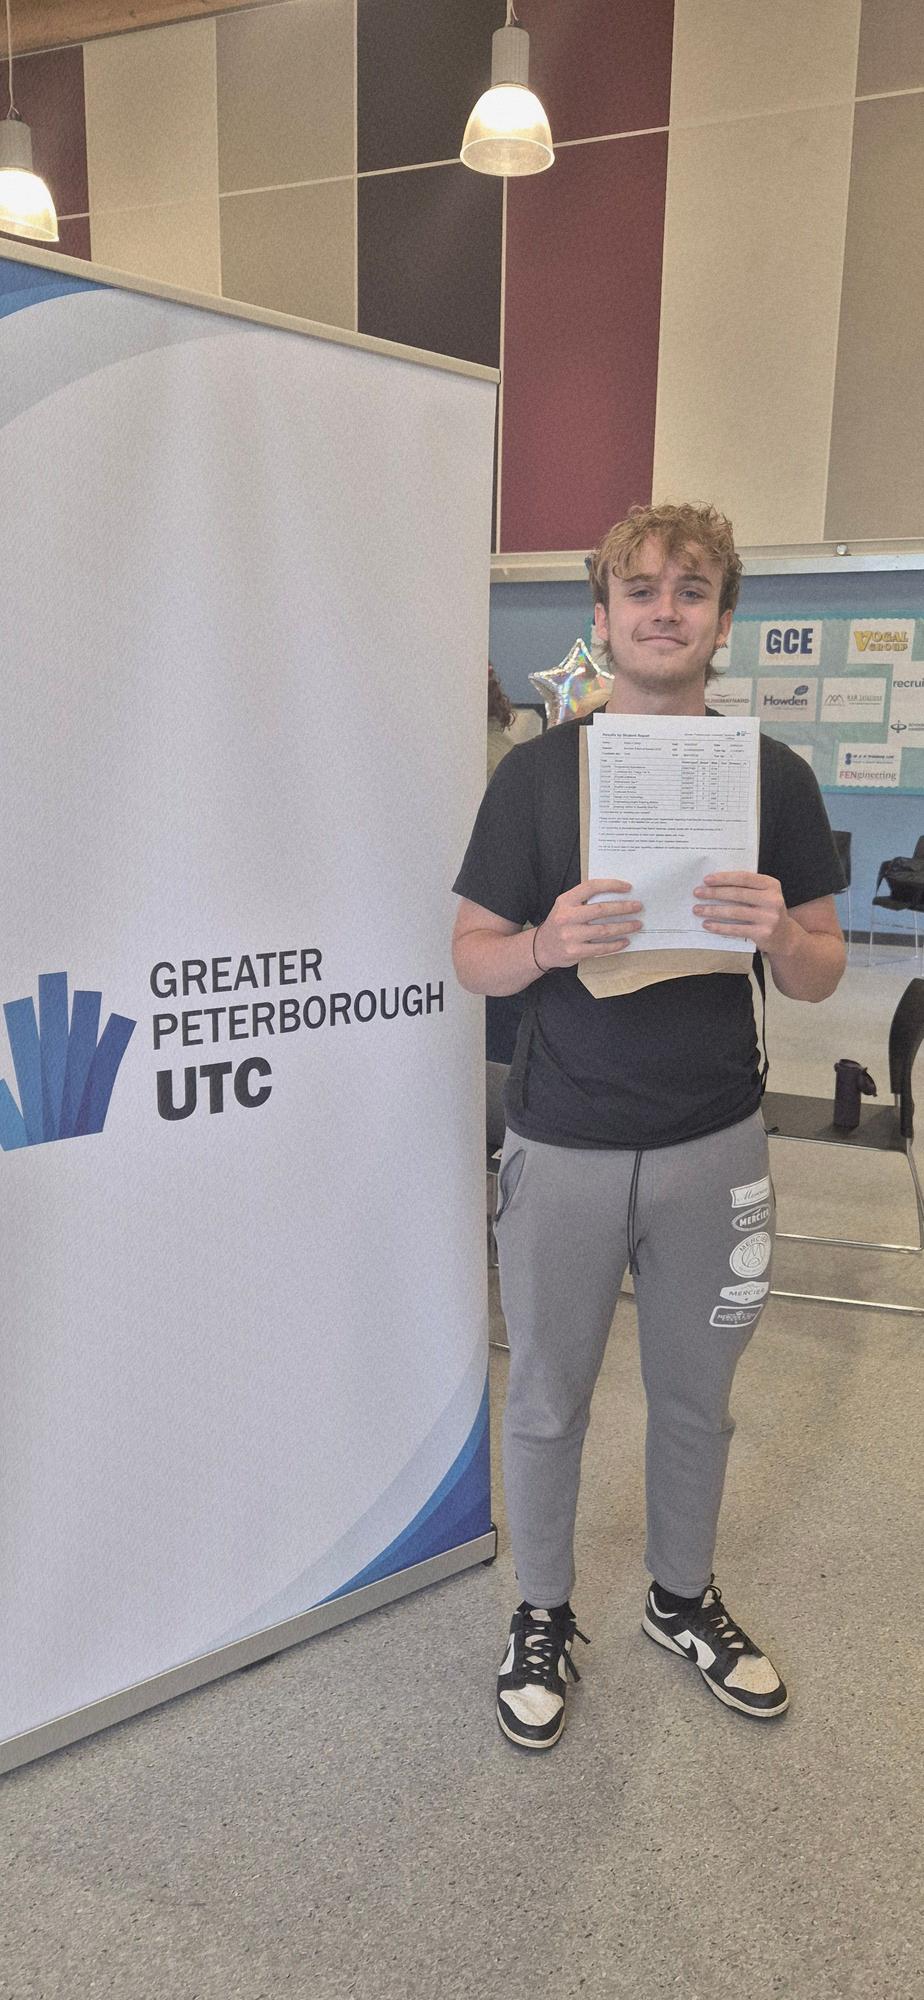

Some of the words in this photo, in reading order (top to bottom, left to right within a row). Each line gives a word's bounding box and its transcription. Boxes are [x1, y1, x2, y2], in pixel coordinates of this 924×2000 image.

[766, 628, 814, 655] GCE
[854, 631, 909, 652] VOGAL
[869, 643, 908, 652] GROUP
[763, 695, 808, 706] Howden
[150, 948, 323, 998] GREATER
[152, 981, 445, 1050] PETERBOROUGH
[156, 1056, 273, 1121] UTC
